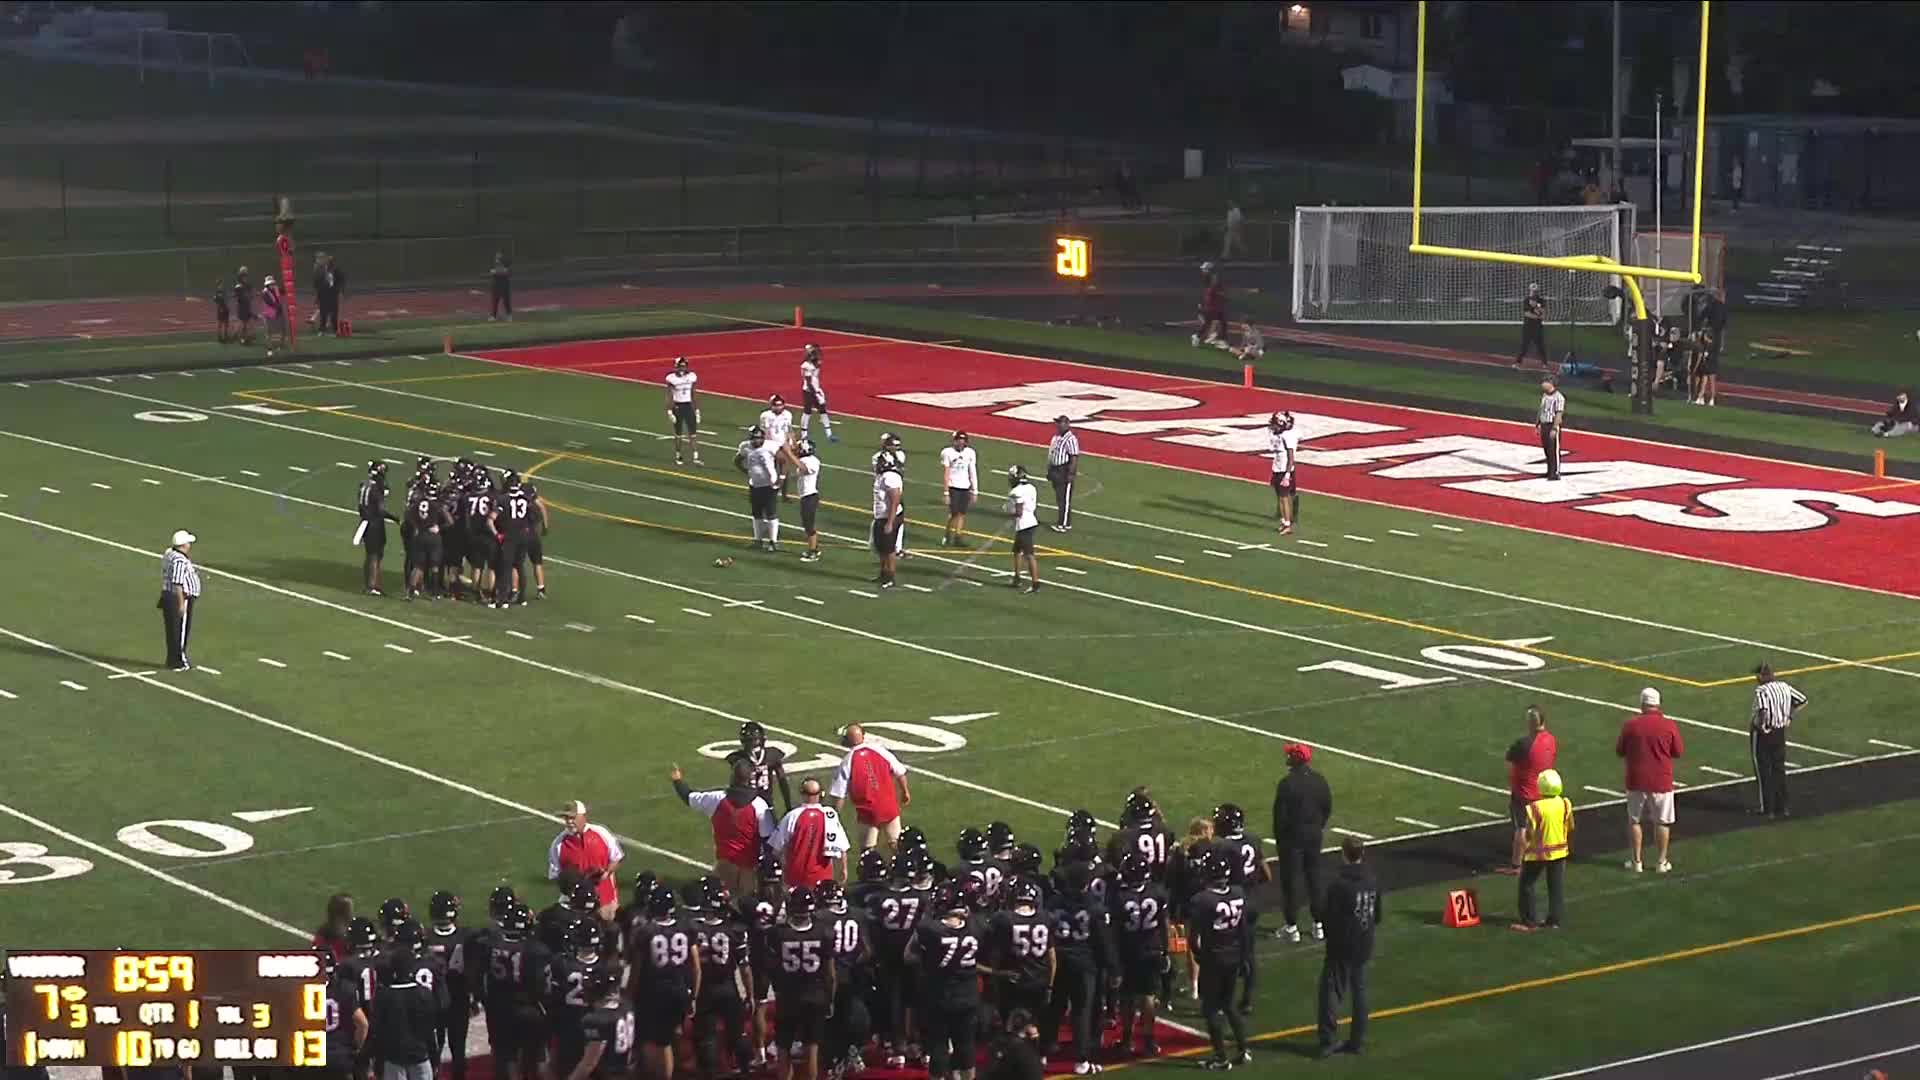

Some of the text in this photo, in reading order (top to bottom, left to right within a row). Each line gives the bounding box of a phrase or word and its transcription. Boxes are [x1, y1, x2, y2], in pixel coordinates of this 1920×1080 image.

[1056, 238, 1088, 277] 20
[882, 379, 1920, 532] RAMS
[468, 496, 490, 516] 76
[510, 498, 528, 519] 13
[1297, 645, 1545, 689] 10
[1138, 833, 1165, 864] 91
[882, 898, 919, 930] 27
[1124, 898, 1158, 930] 32
[1213, 899, 1243, 930] 25
[1455, 895, 1477, 921] 20
[651, 932, 688, 968] 89
[833, 919, 859, 952] 10
[1012, 923, 1049, 957] 59
[782, 940, 821, 973] 55
[940, 936, 978, 968] 72
